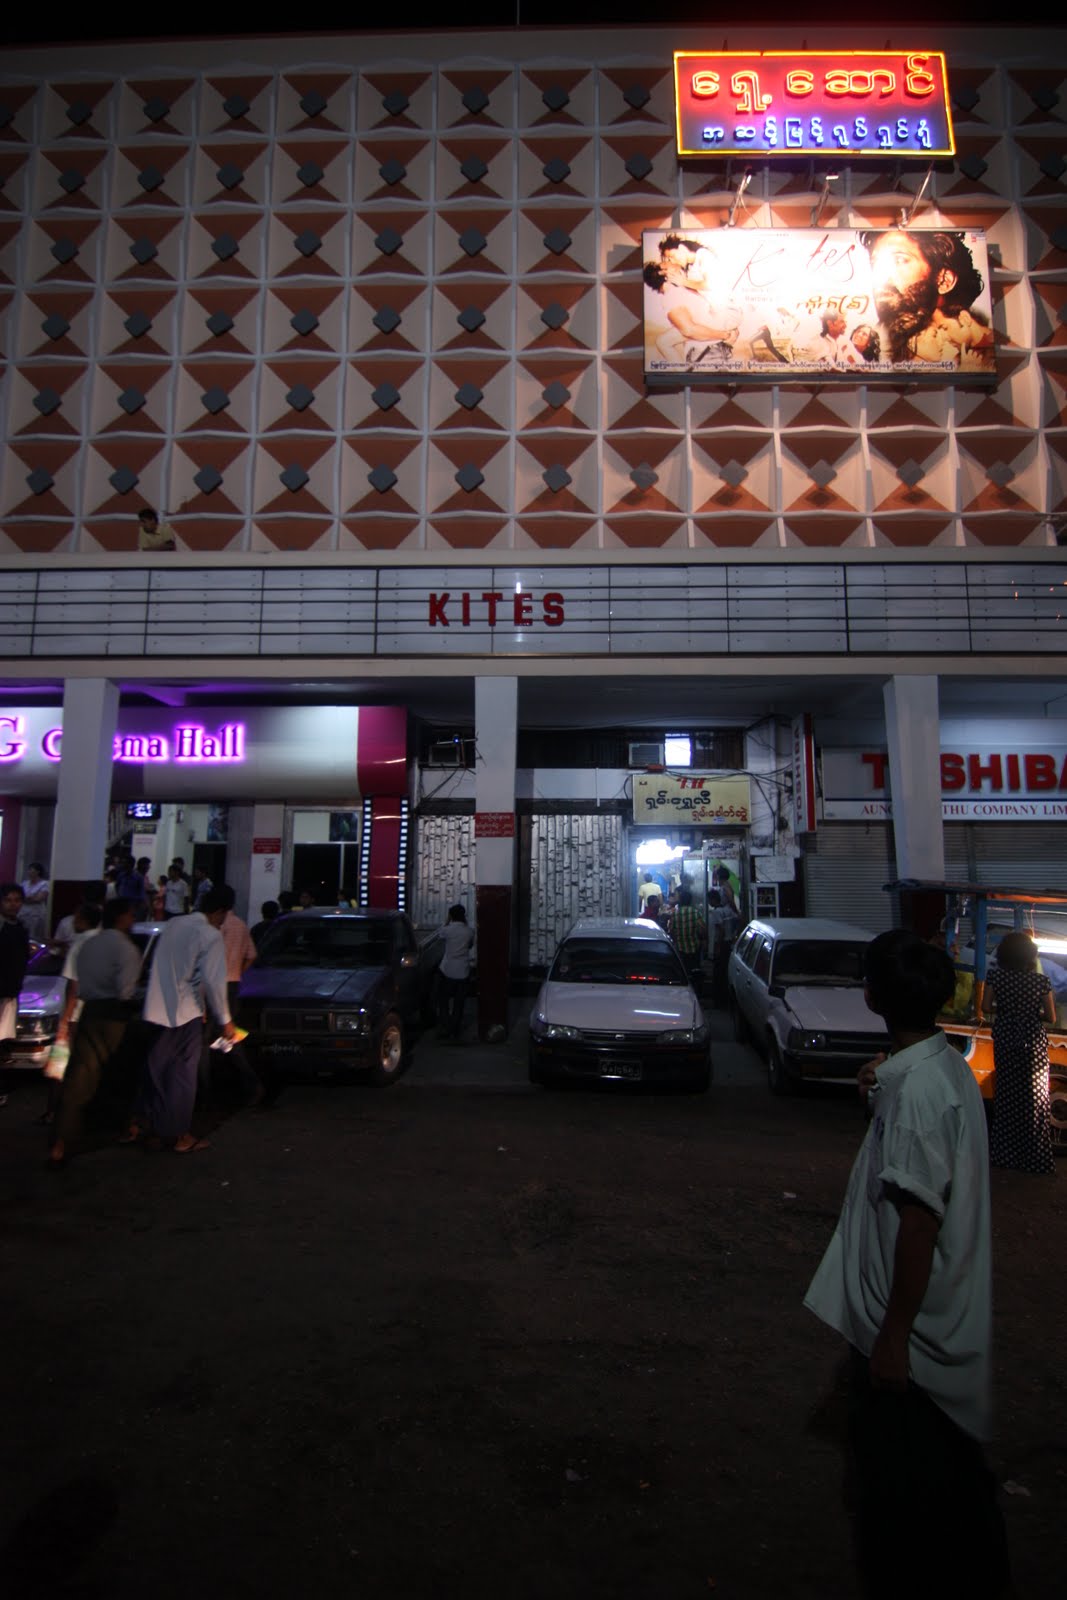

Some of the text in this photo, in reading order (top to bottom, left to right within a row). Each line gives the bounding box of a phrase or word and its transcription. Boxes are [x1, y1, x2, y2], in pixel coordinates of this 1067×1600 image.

[428, 592, 565, 627] KITES
[175, 723, 244, 761] Hall
[861, 753, 1067, 790] TSHIB
[973, 804, 1038, 816] COMPANY
